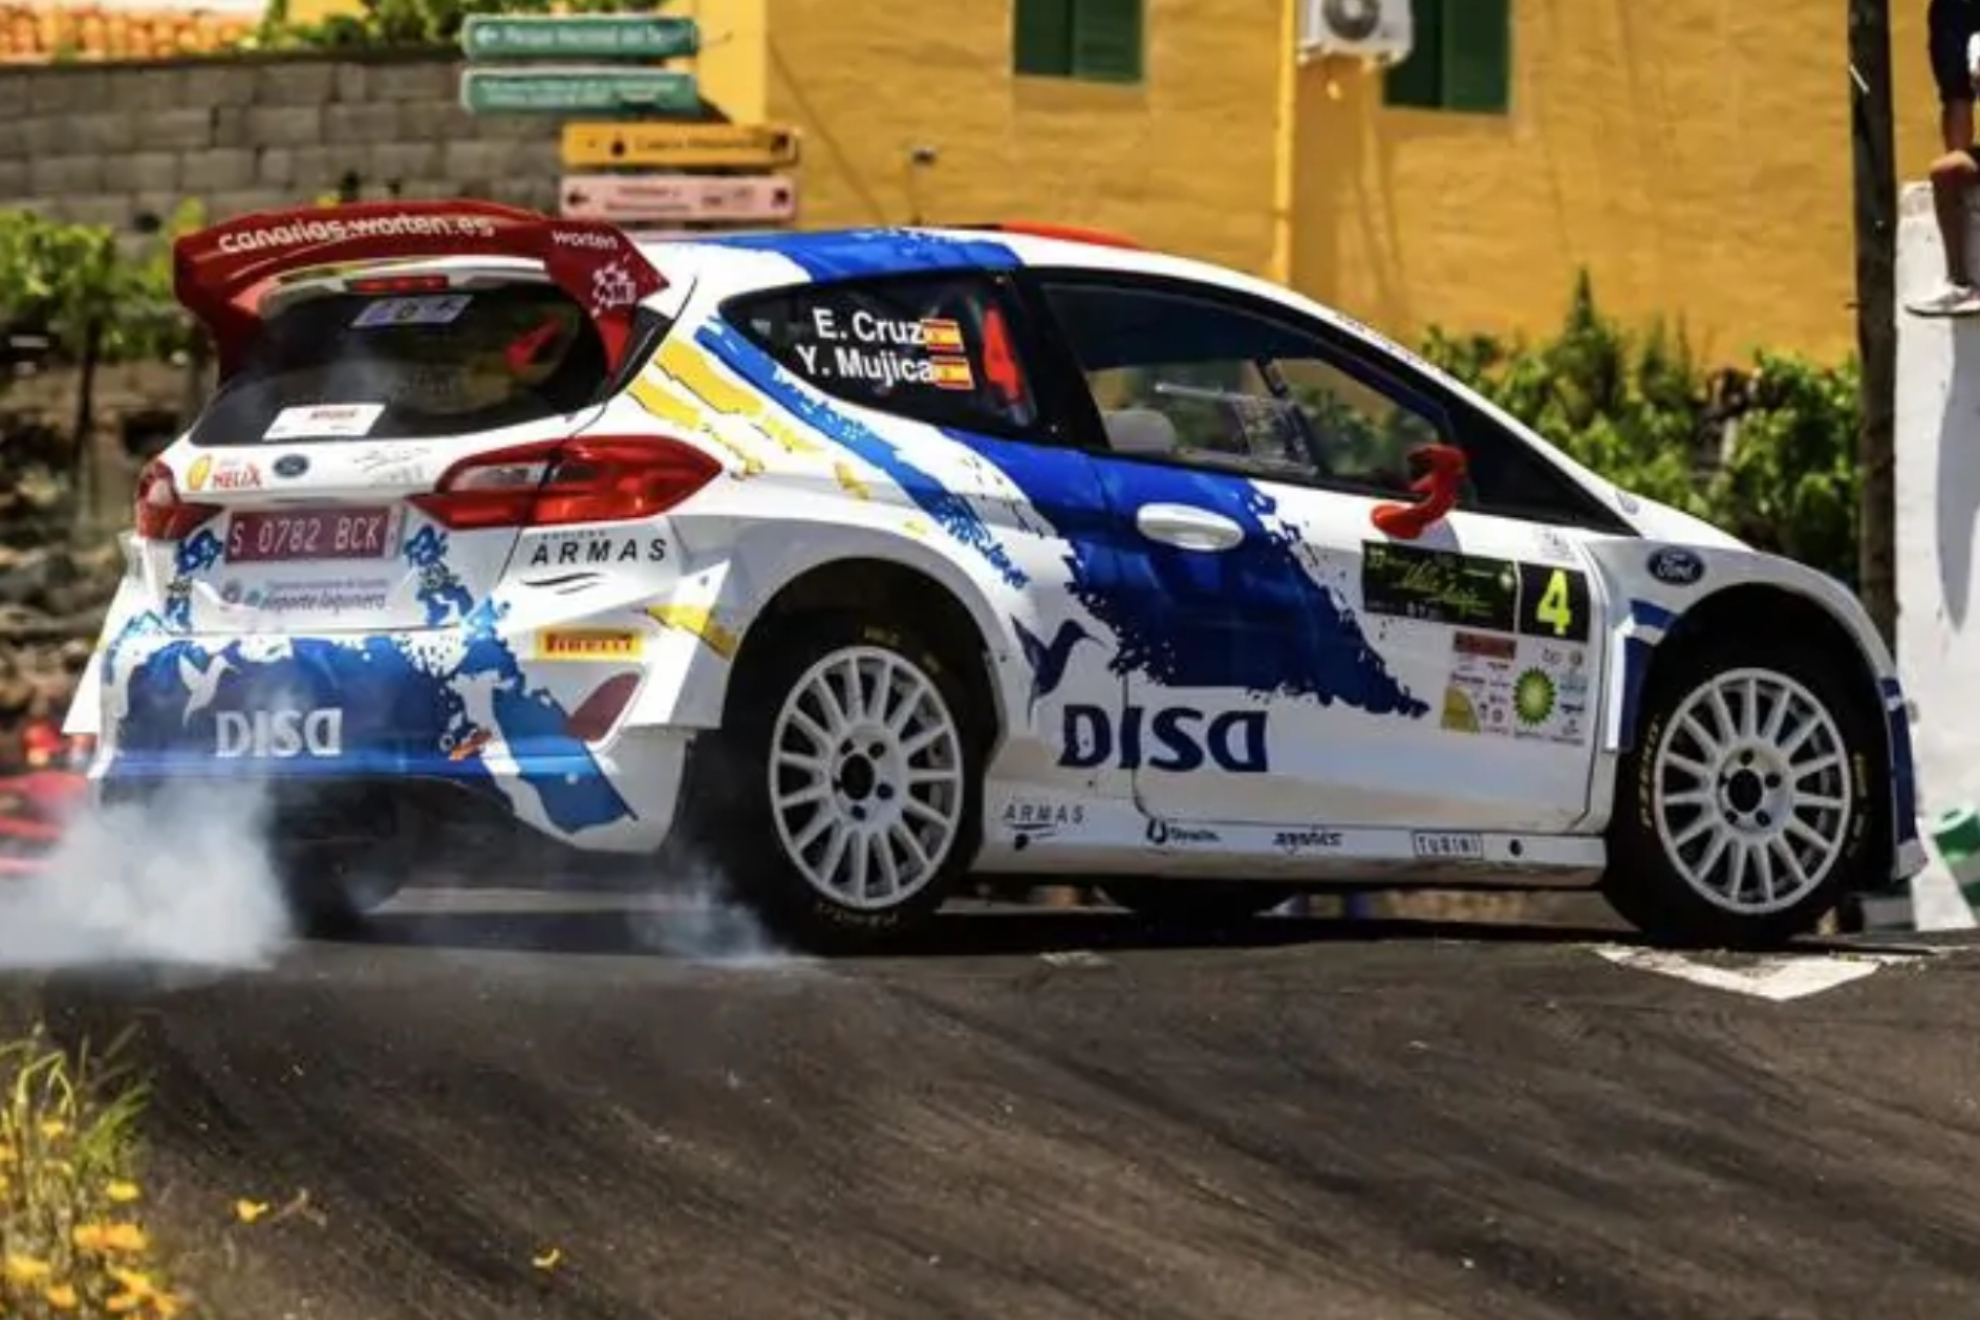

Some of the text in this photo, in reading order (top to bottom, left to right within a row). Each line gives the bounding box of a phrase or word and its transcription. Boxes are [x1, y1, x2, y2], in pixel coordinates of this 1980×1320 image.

[551, 230, 619, 250] worten
[813, 306, 927, 345] E. Cruz
[795, 343, 935, 388] Y. Mujica
[231, 521, 245, 556] S
[257, 517, 321, 553] 0782
[334, 513, 381, 550] BCK
[531, 538, 667, 567] ARMAS
[1536, 569, 1571, 635] 4
[1003, 803, 1084, 824] ARMAS
